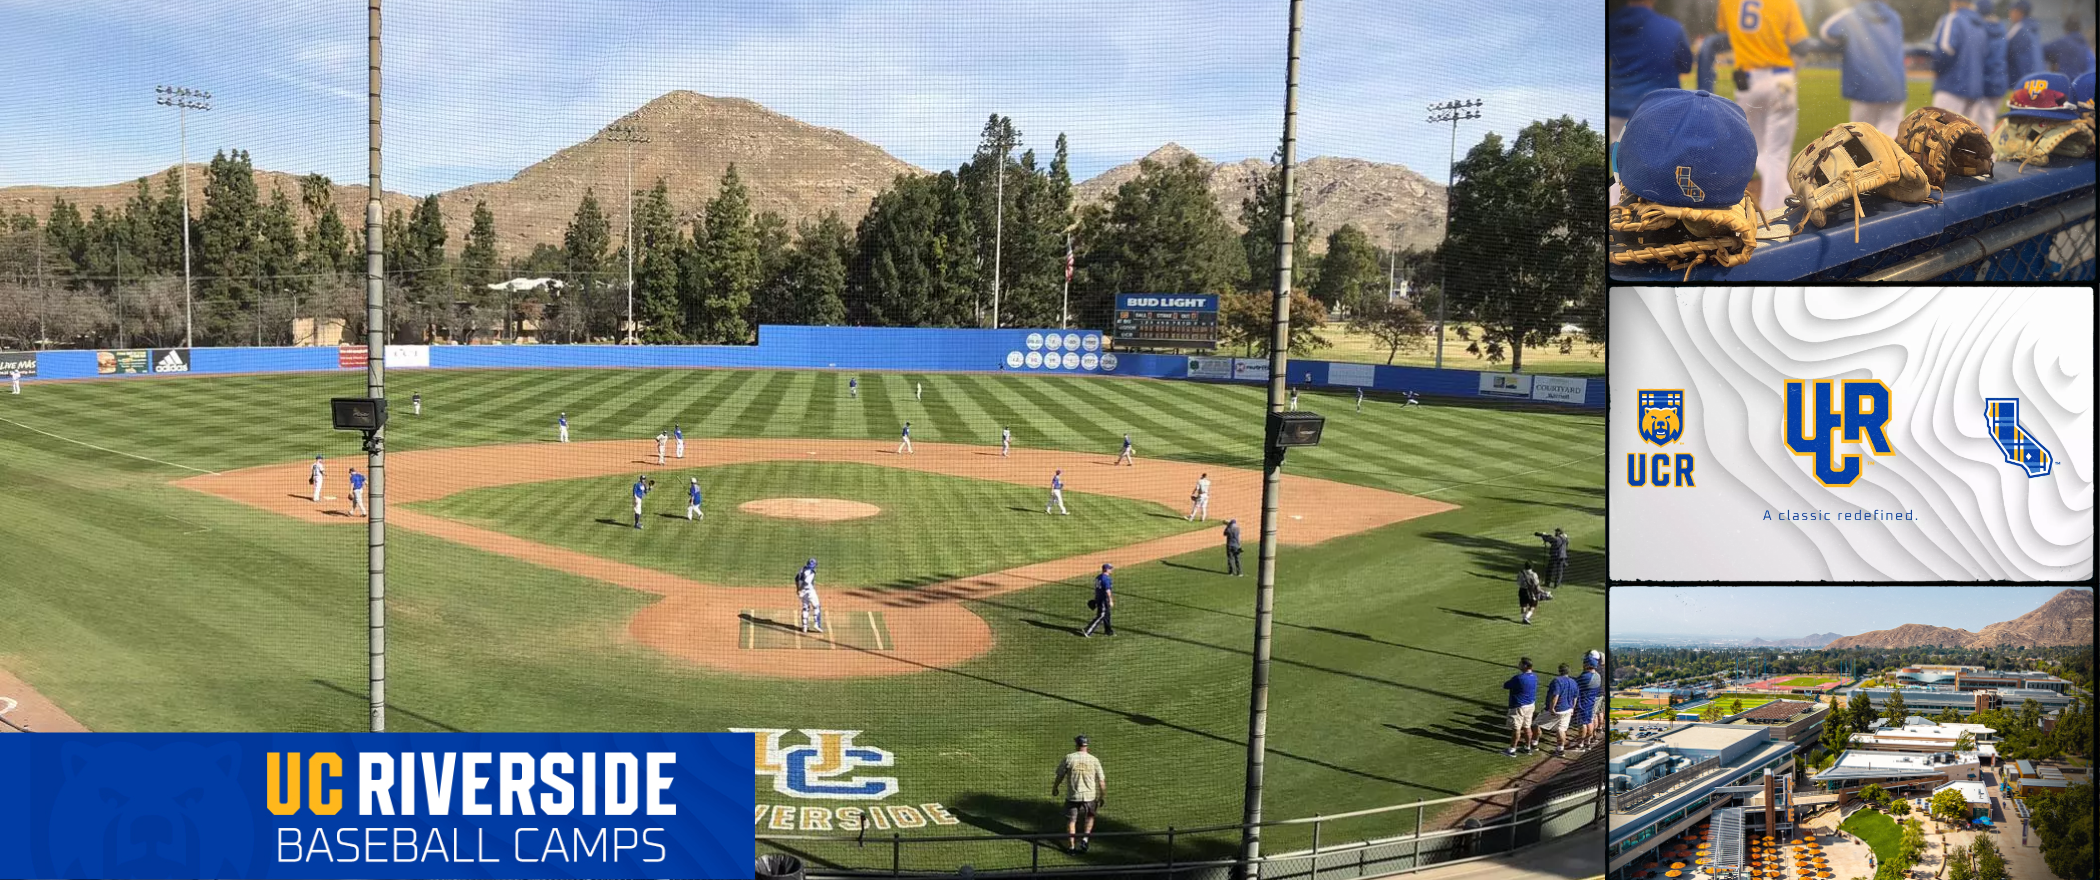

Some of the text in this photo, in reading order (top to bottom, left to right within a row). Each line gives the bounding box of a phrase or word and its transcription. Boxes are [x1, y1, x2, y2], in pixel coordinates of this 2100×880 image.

[1738, 0, 1763, 32] 6
[1127, 298, 1206, 307] BUD LIGHT
[155, 363, 188, 373] adidas
[1536, 384, 1581, 394] COURTYARD
[1627, 453, 1696, 487] UCR
[1762, 509, 1918, 521] A classic redefined.
